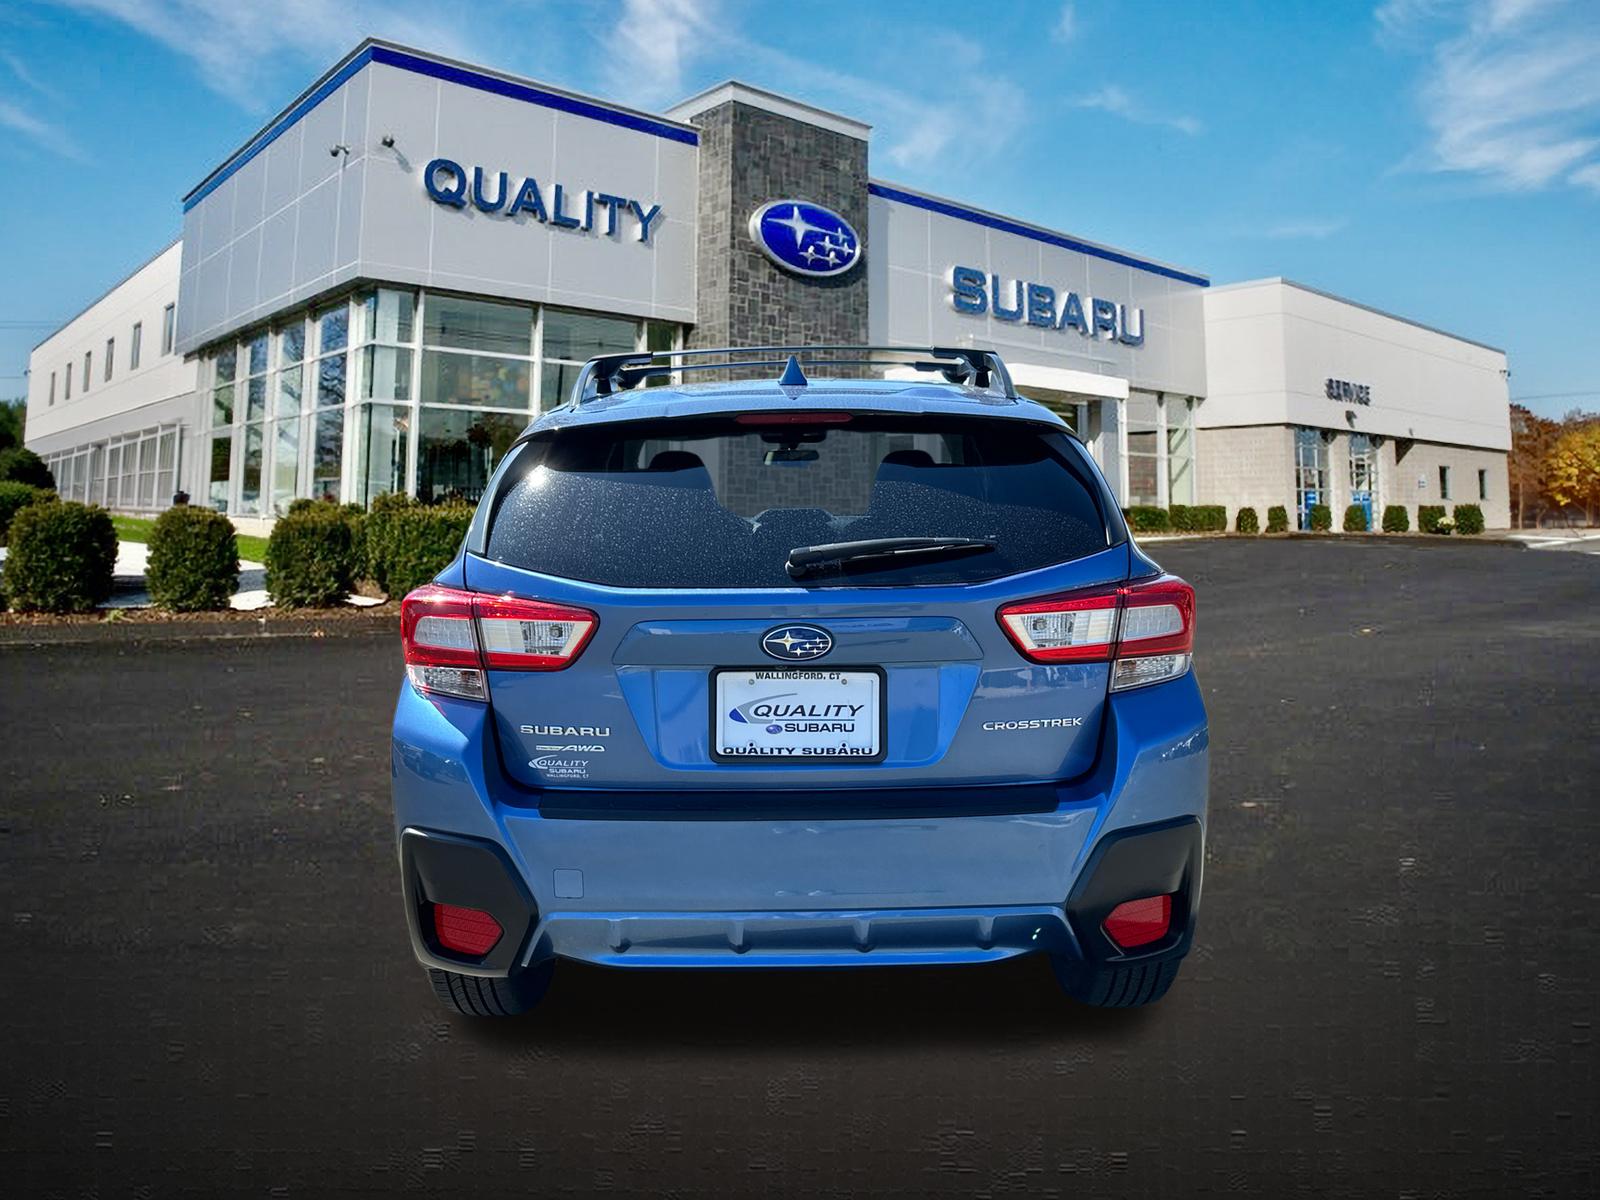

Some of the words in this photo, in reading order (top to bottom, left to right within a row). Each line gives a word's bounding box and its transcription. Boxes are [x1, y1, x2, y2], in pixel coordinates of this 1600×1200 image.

[424, 158, 661, 242] QUALITY
[951, 265, 1145, 347] SUBARU
[829, 672, 841, 680] CT
[753, 704, 864, 717] QUALITY
[784, 723, 855, 733] SUBARU
[982, 717, 1083, 731] CROSSTREK
[520, 724, 610, 737] SUBARU
[561, 744, 606, 752] AWD
[723, 747, 796, 755] QUALITY
[802, 747, 873, 755] SUBARU
[538, 759, 589, 767] QUALITY
